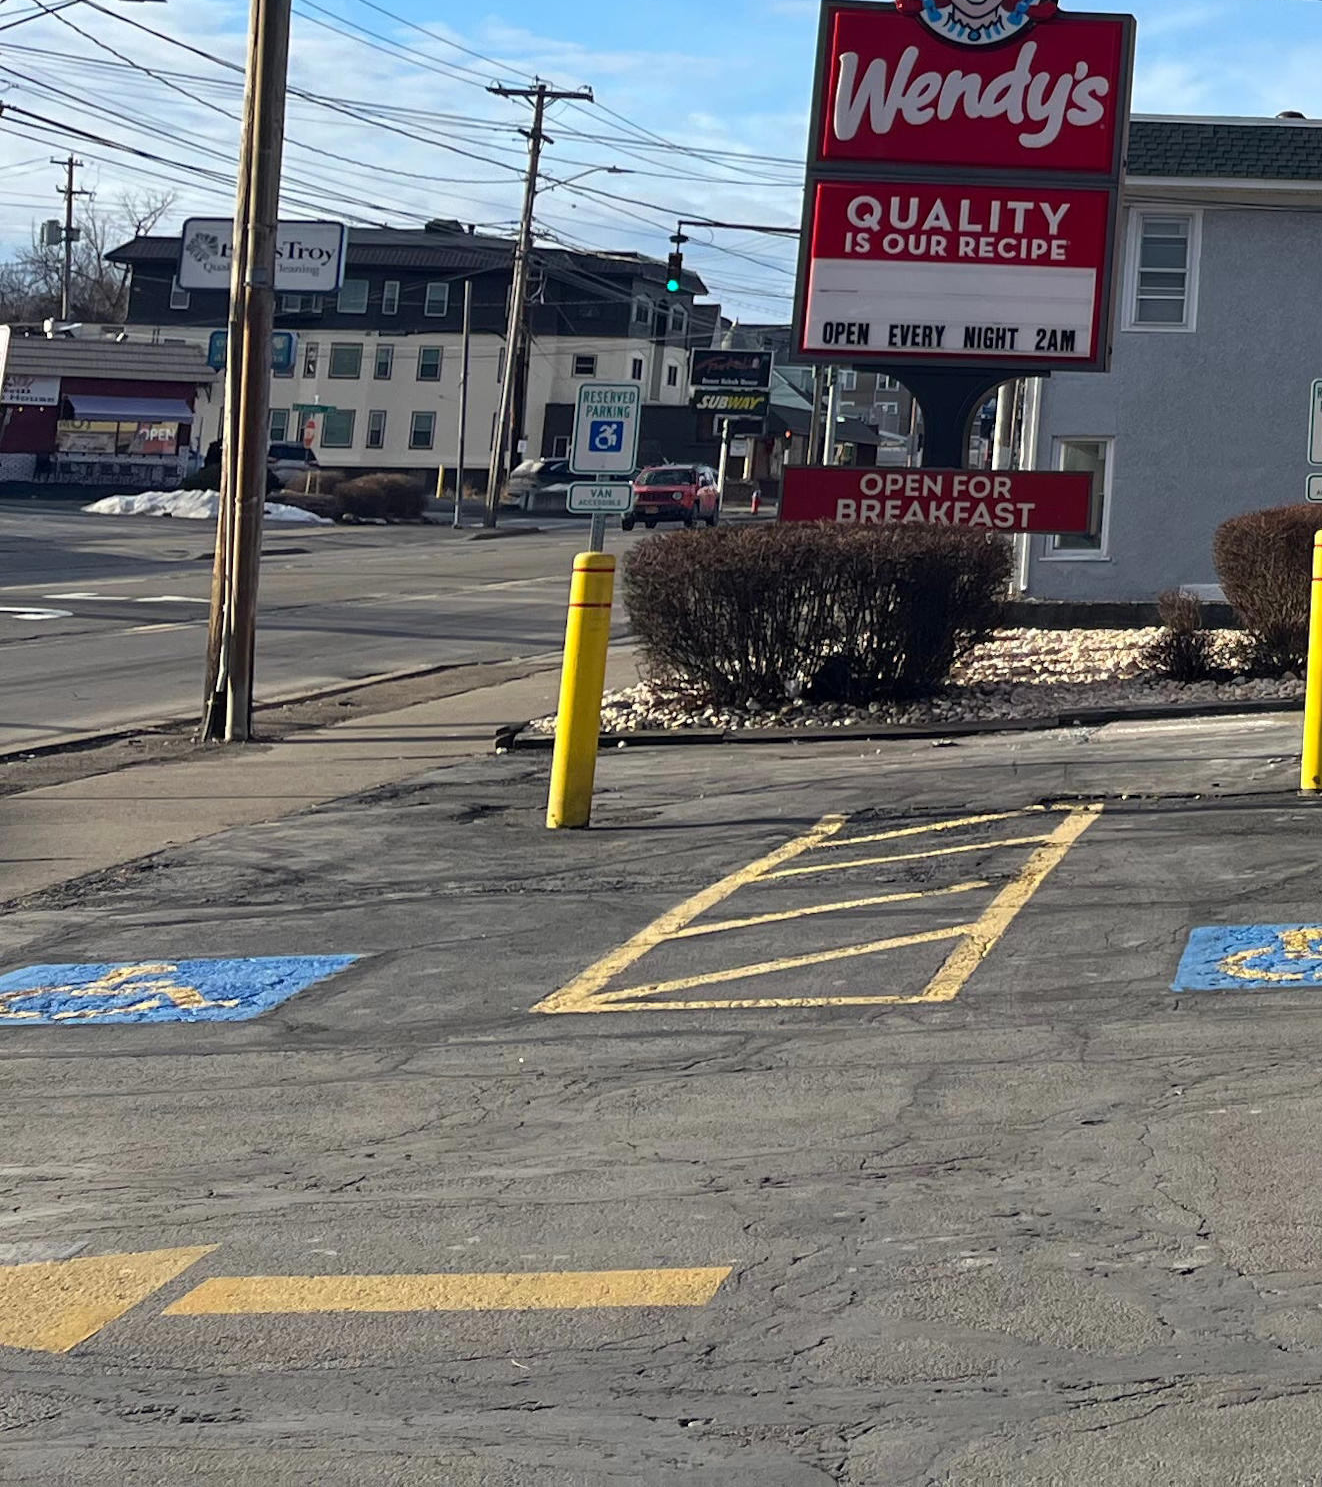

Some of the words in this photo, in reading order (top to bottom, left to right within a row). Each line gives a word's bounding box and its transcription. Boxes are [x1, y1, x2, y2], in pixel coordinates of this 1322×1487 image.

[833, 40, 1109, 149] Wendy's
[846, 195, 1071, 235] QUALITY
[844, 232, 871, 254] IS
[882, 234, 947, 257] OUR
[958, 236, 1068, 261] RECIPE
[822, 321, 870, 346] OPEN
[887, 324, 946, 348] EVERY
[963, 326, 1019, 351] NIGHT
[1035, 328, 1076, 352] 2AM
[583, 390, 636, 404] RESERVED
[696, 395, 765, 409] SUBWAY
[585, 405, 631, 419] PARKING
[591, 489, 612, 498] VAN
[859, 473, 943, 497] OPEN
[952, 476, 1012, 499] FOR
[835, 499, 1036, 528] BREAKFAST
